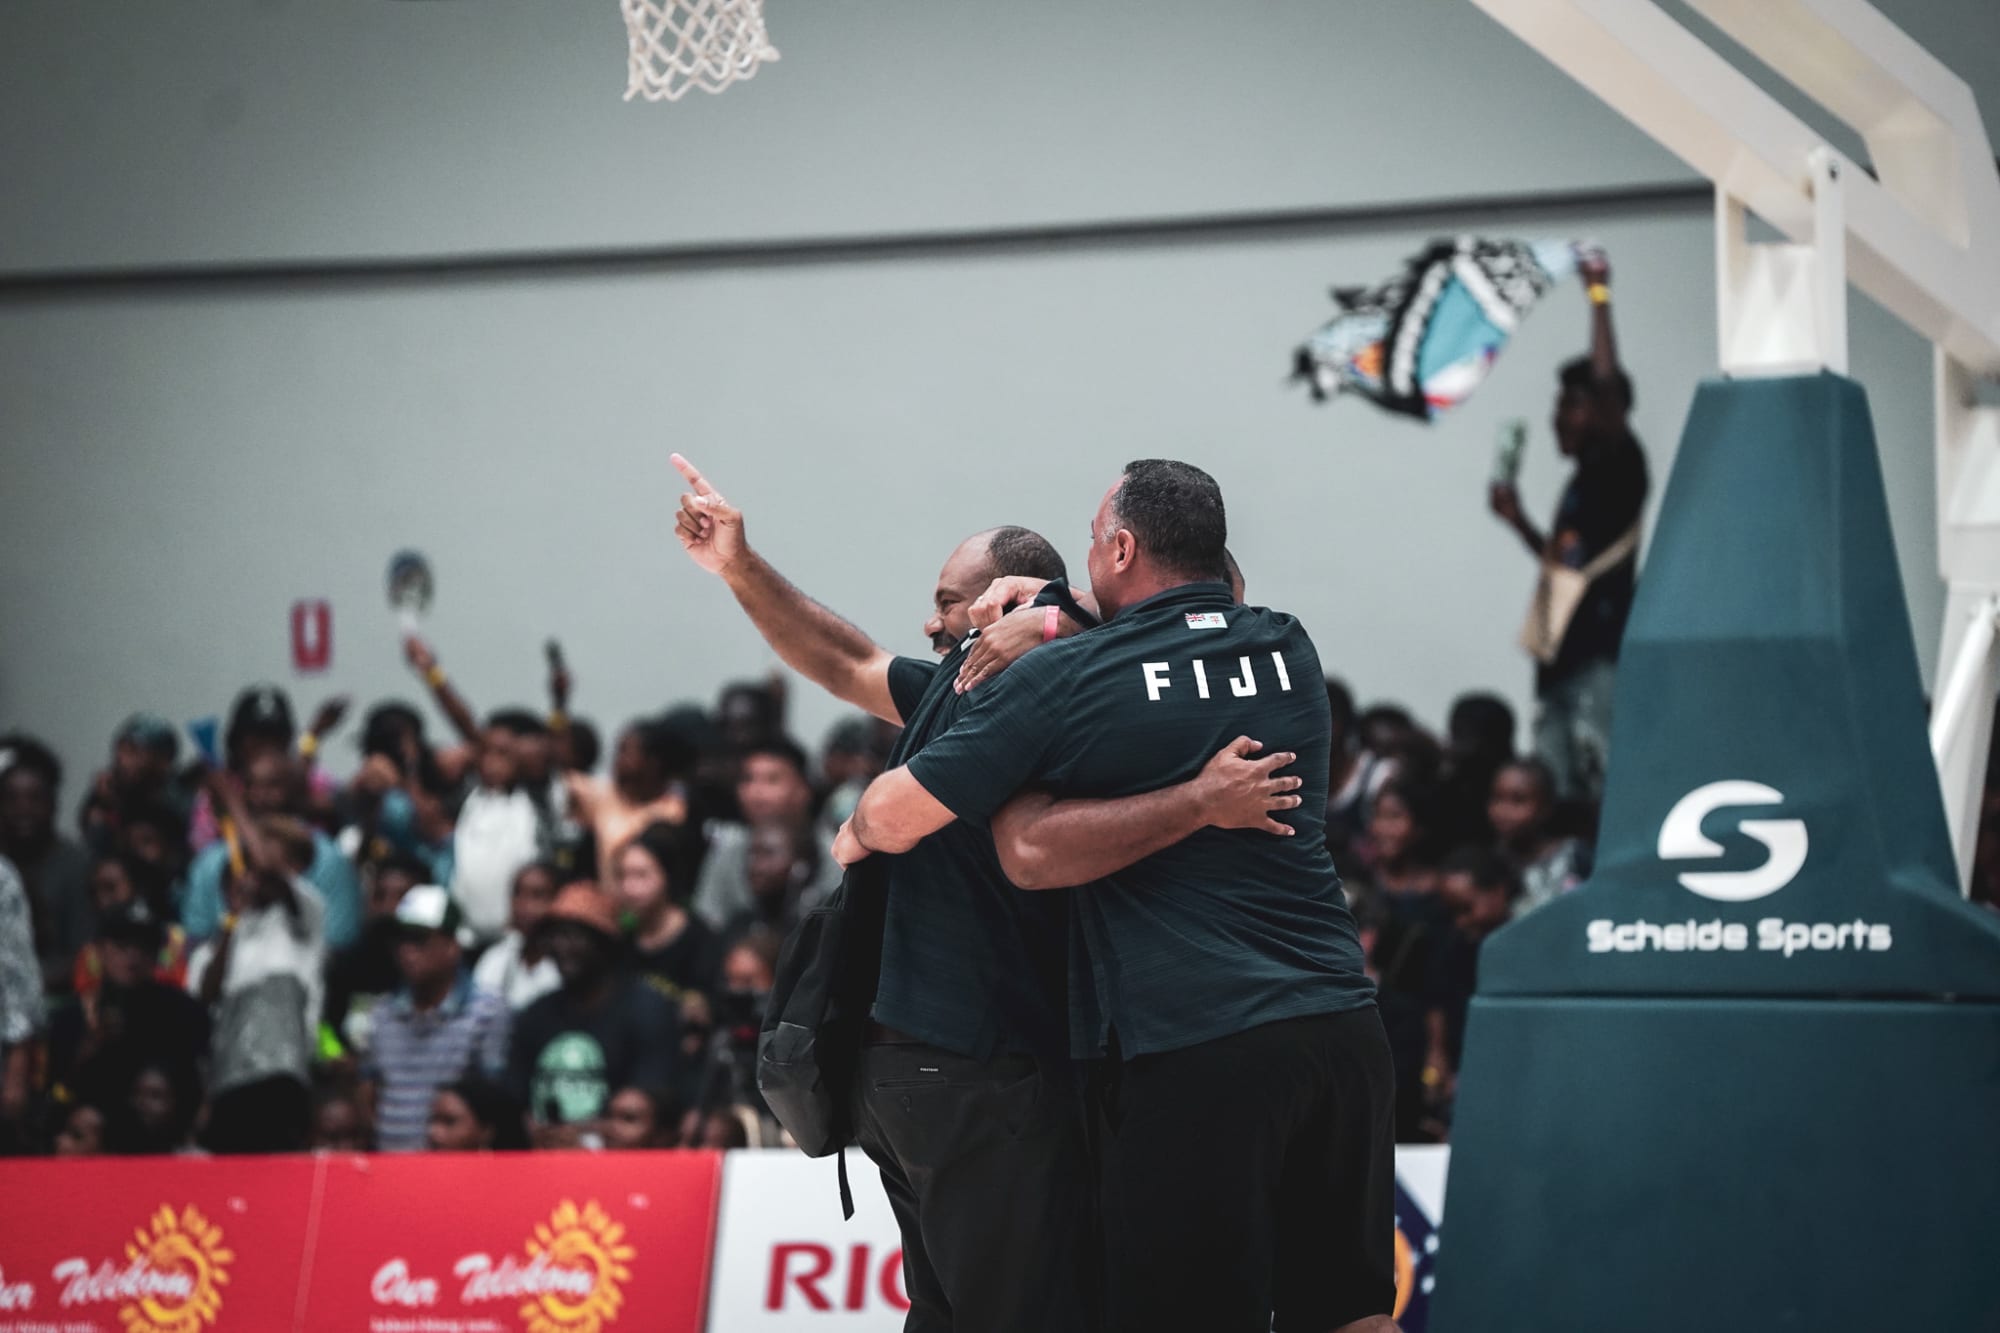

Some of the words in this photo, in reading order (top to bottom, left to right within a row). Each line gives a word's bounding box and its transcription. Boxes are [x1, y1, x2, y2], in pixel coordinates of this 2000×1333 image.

[1141, 651, 1292, 701] FIJI
[1756, 917, 1893, 958] Sports
[370, 1258, 437, 1307] Our
